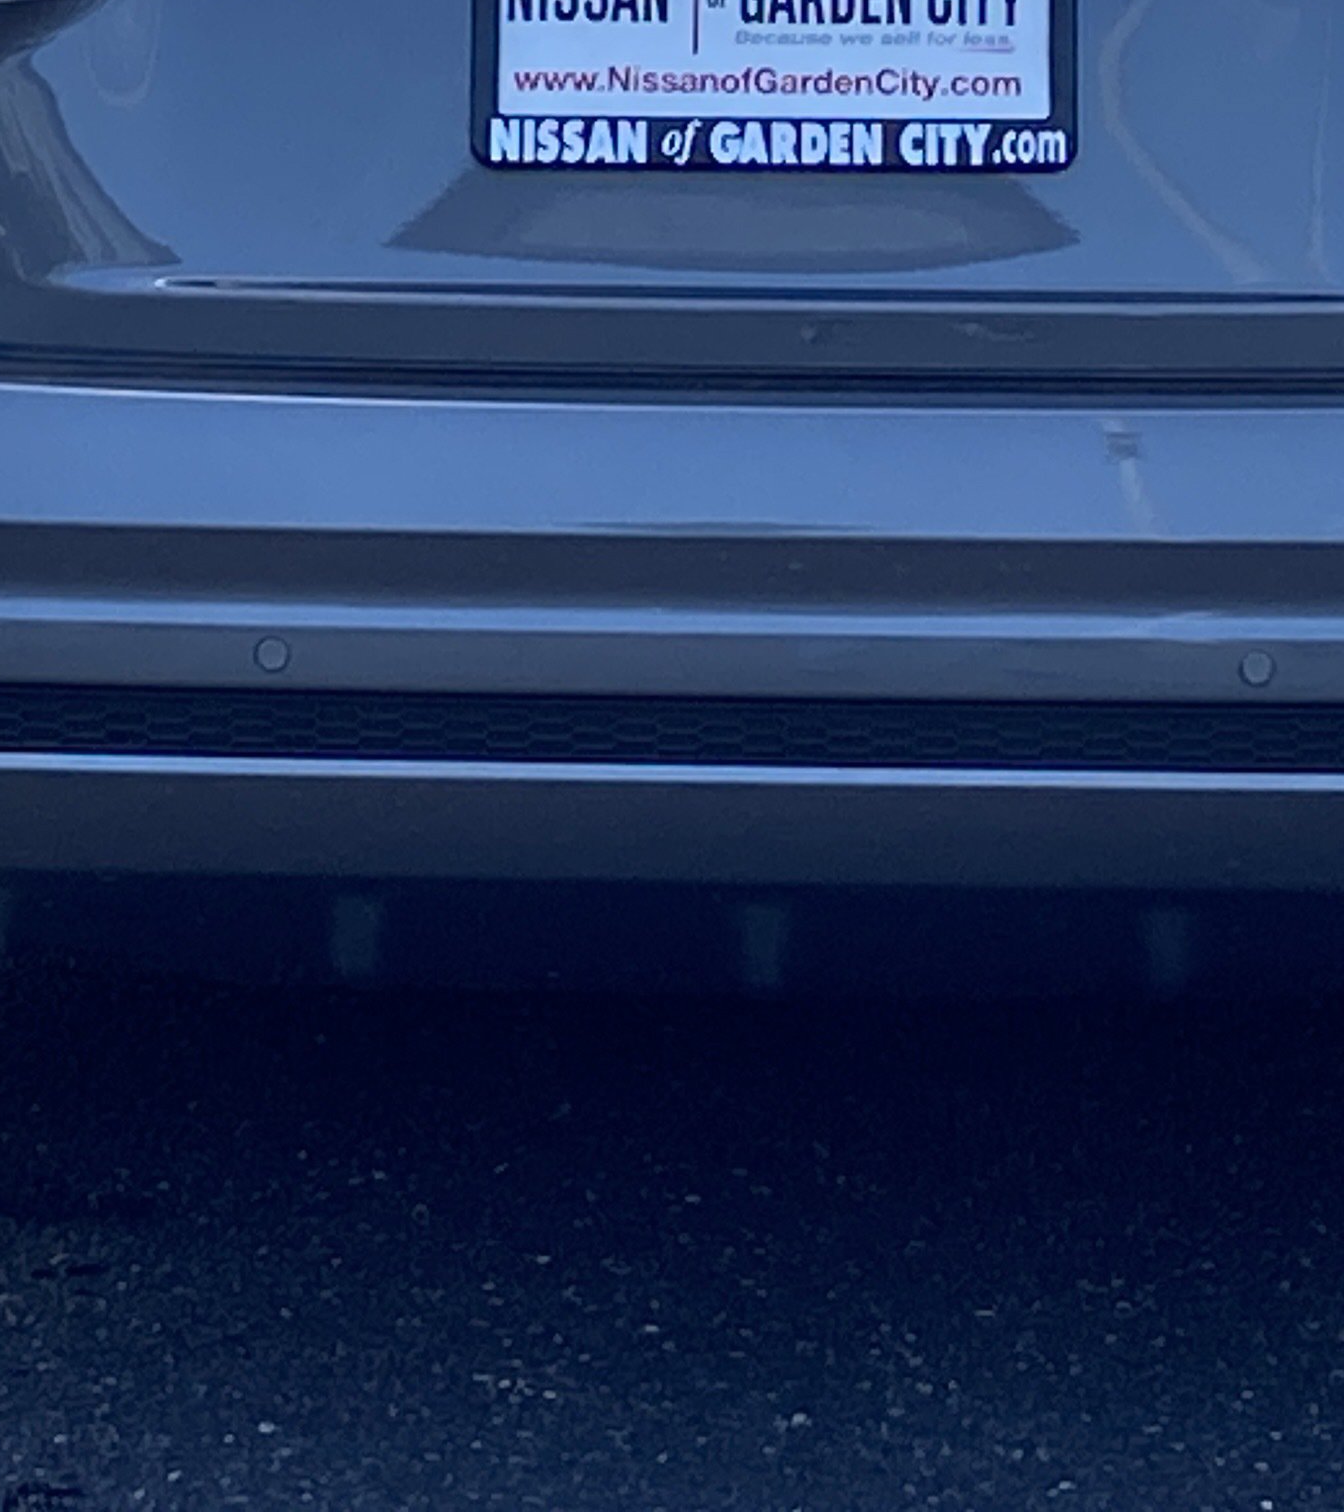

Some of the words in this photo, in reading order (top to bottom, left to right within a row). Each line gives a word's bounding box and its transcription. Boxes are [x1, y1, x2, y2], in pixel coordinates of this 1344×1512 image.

[735, 29, 833, 46] Because
[840, 32, 875, 46] we
[880, 30, 921, 46] sell
[927, 30, 957, 46] for
[513, 65, 1023, 101] www.NissanofGardenCity.com
[490, 118, 648, 165] NISSAN
[660, 118, 703, 166] of
[709, 120, 884, 166] GARDEN
[898, 122, 1067, 167] CITY.com
